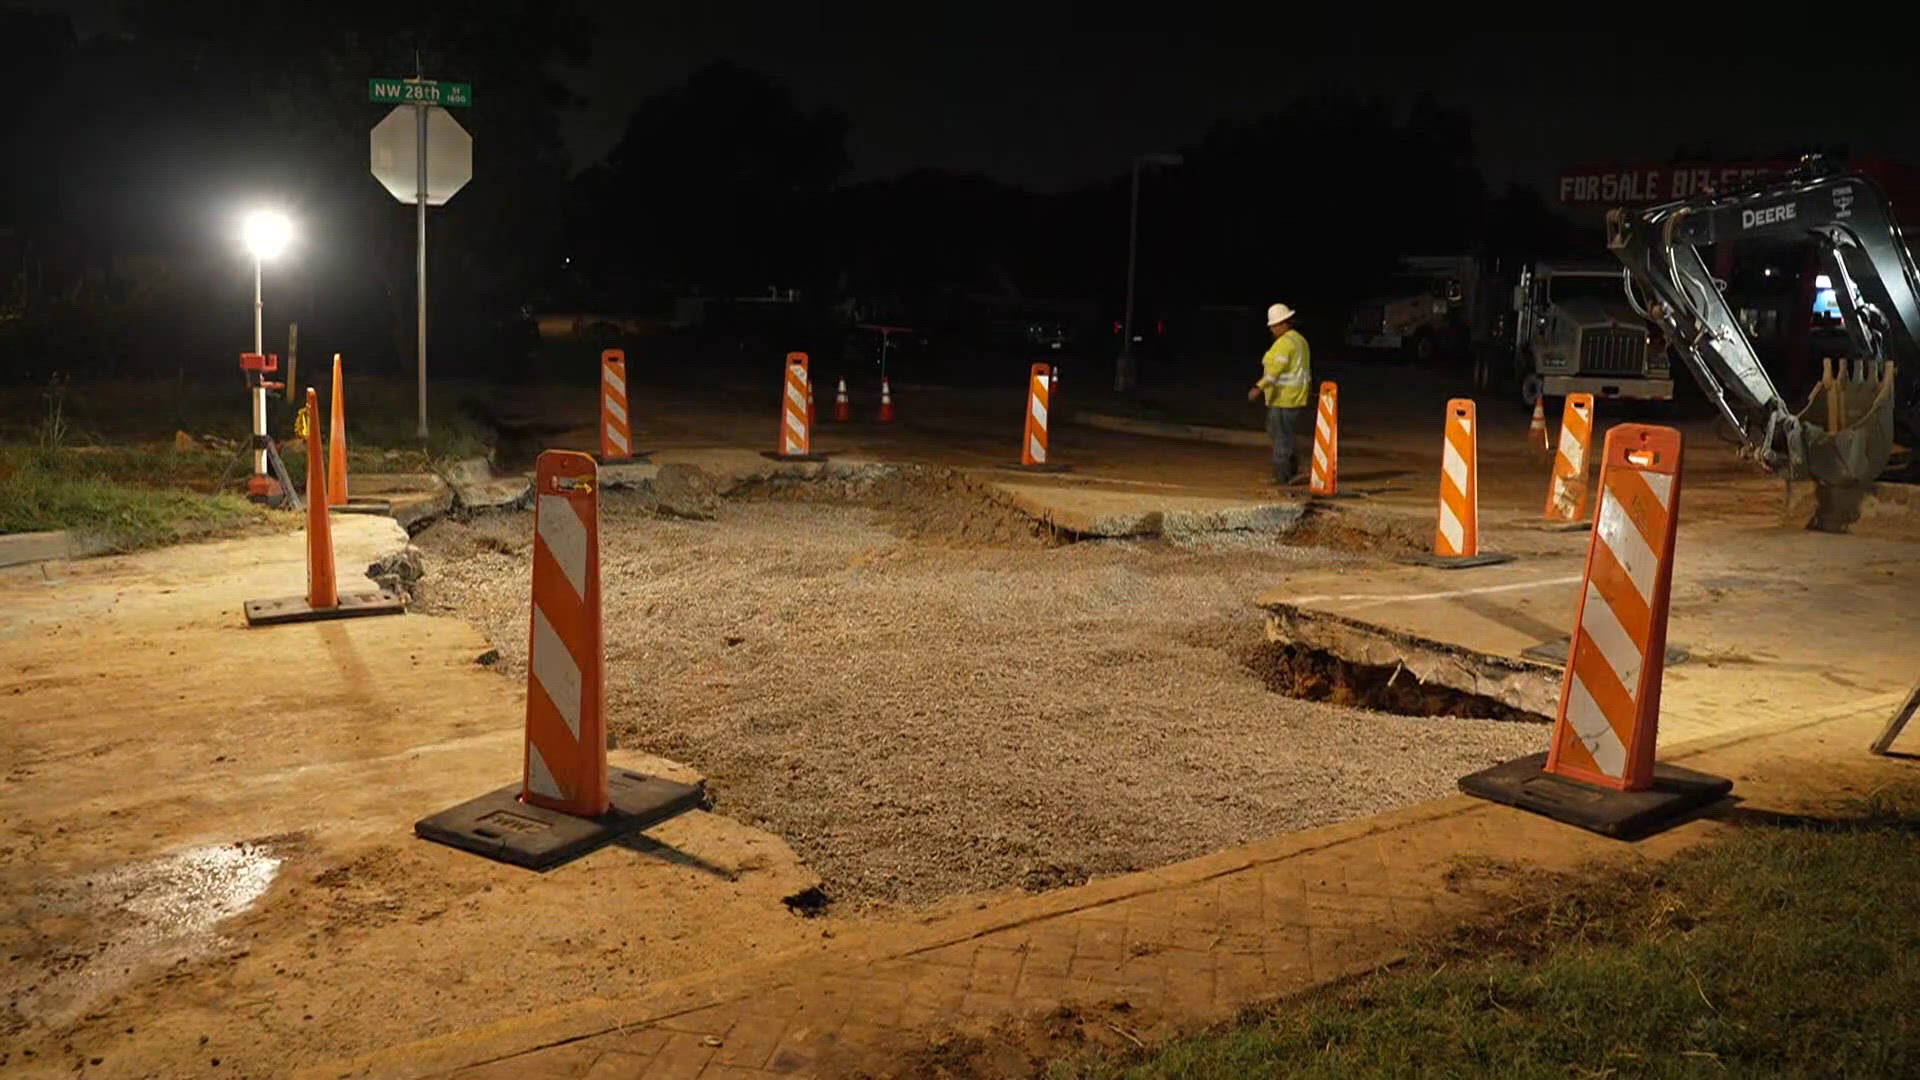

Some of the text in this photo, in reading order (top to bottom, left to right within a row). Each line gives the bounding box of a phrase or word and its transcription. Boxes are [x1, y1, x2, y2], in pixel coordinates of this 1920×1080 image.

[375, 83, 401, 98] NW
[405, 84, 441, 101] 28th
[1742, 202, 1797, 230] DEERE
